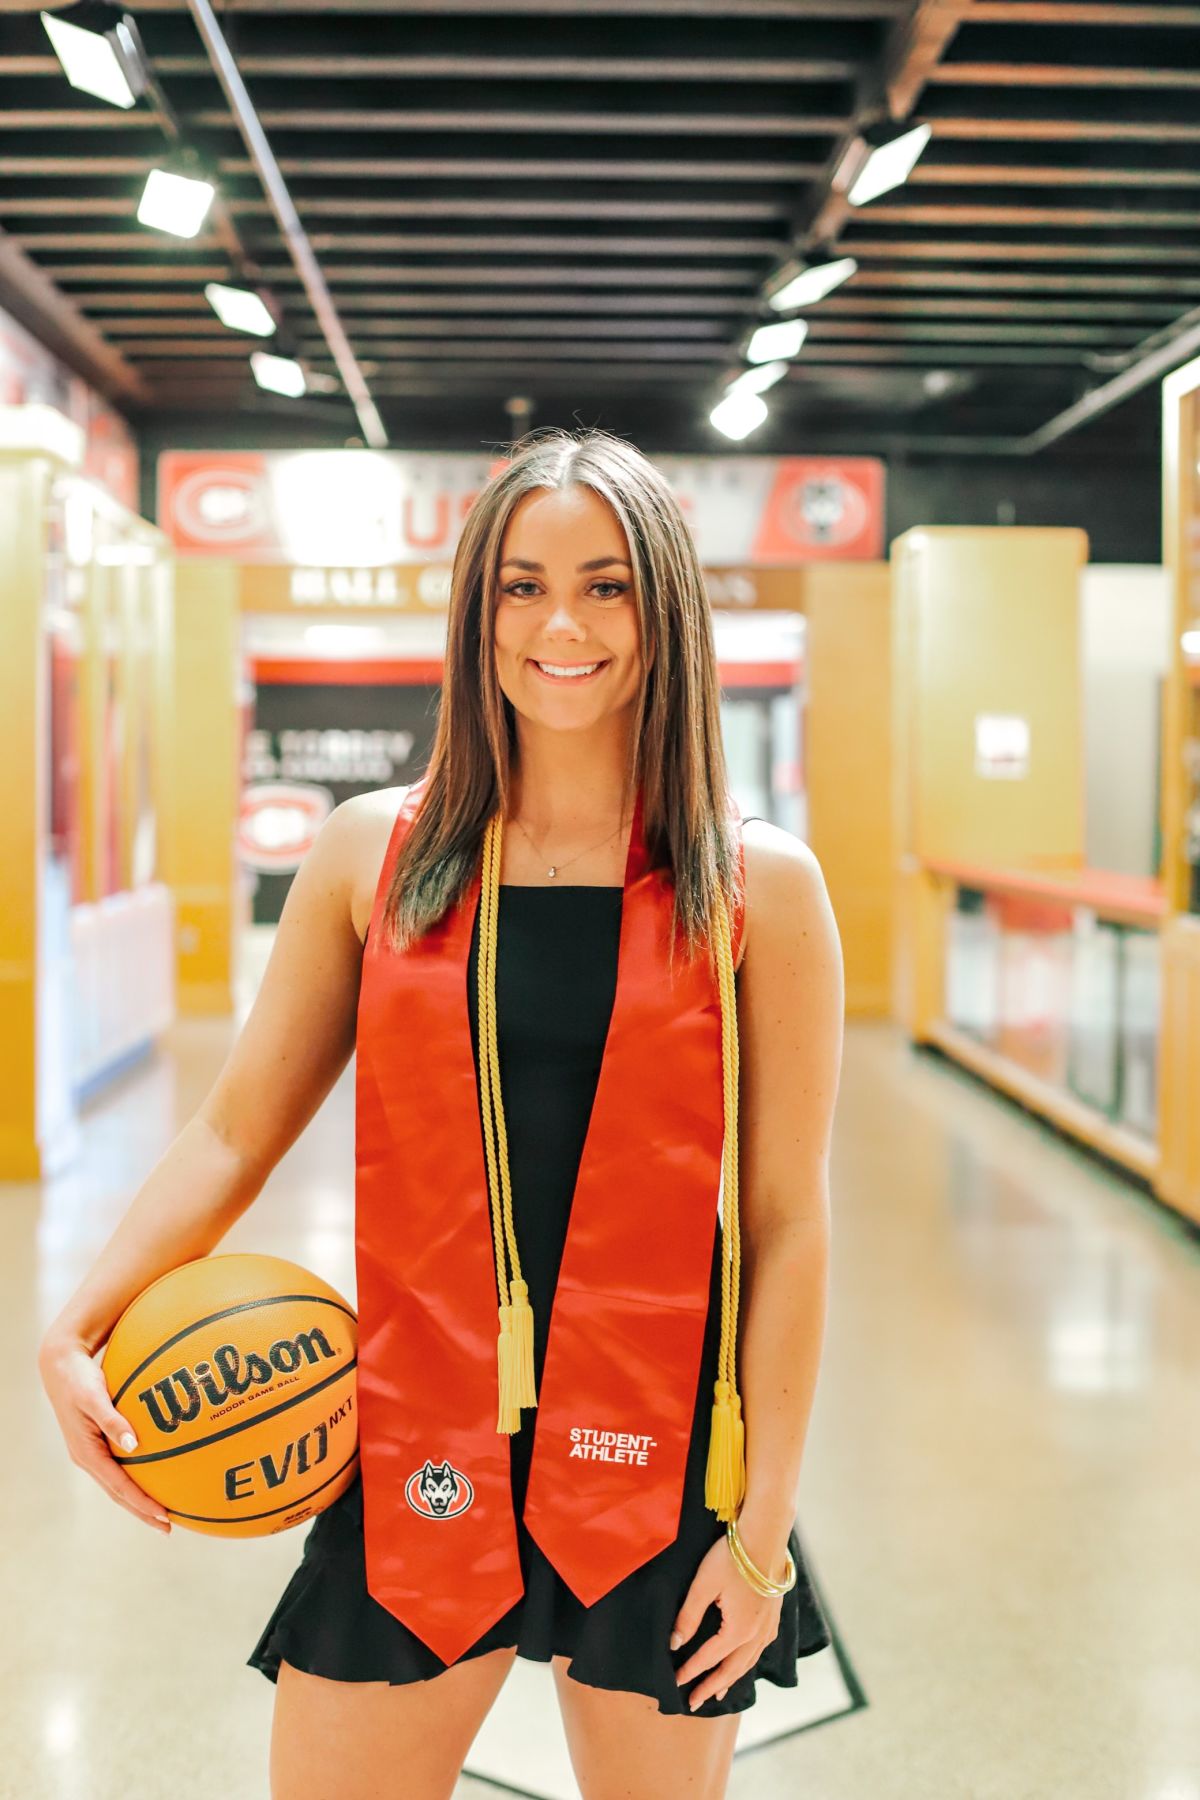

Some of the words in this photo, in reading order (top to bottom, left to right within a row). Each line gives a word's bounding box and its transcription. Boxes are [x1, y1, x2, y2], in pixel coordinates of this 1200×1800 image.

[138, 1327, 337, 1434] Wilson
[209, 1399, 246, 1421] INDOOR
[247, 1386, 275, 1401] GAME
[277, 1376, 301, 1389] BALL
[328, 1395, 353, 1429] NXT
[569, 1427, 658, 1451] STUDENT-
[569, 1443, 649, 1466] ATHLETE
